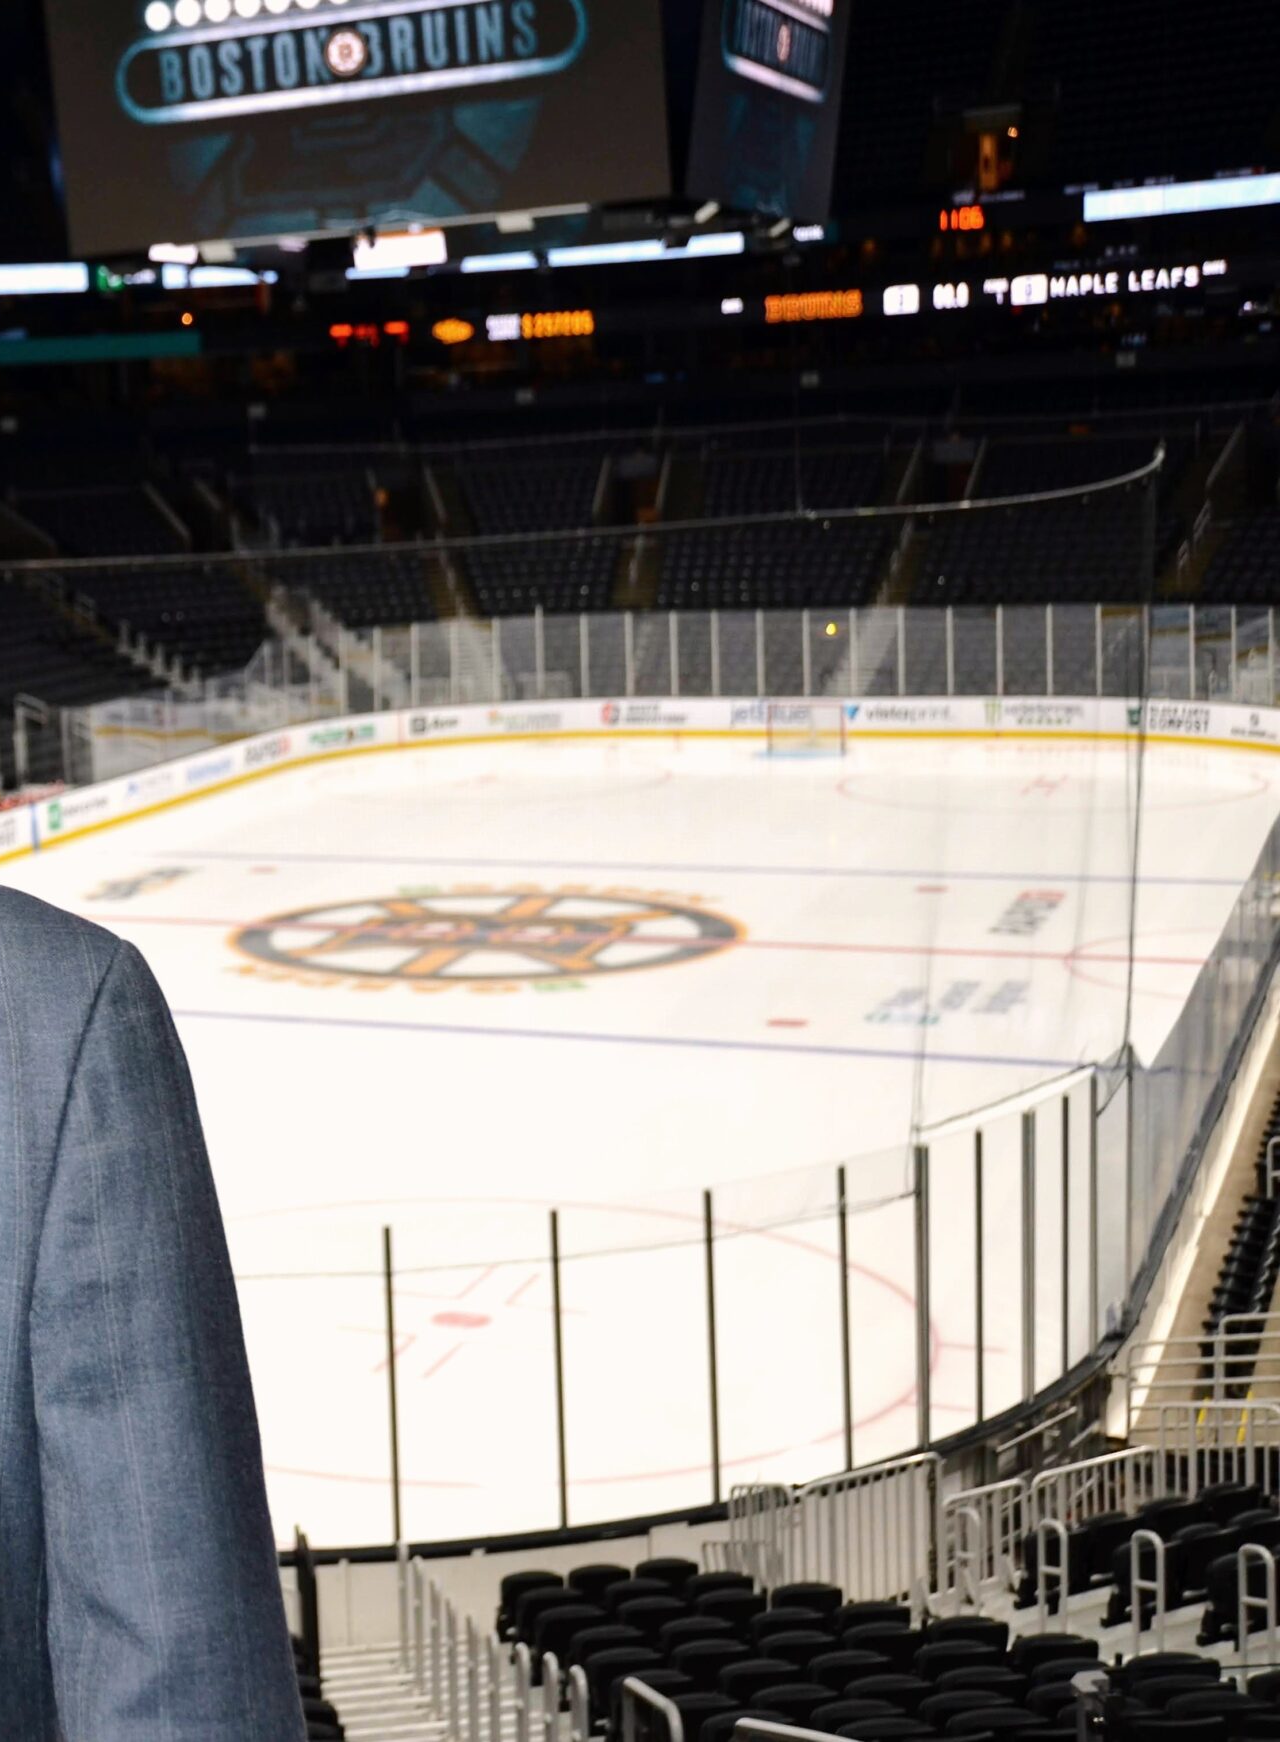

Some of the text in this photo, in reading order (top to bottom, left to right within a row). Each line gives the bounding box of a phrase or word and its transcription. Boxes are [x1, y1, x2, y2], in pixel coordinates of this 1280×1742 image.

[159, 4, 538, 102] BOSTON BRUINS
[1050, 271, 1119, 298] MAPLE
[1128, 259, 1200, 290] LEAFS
[765, 289, 862, 323] BRUINS
